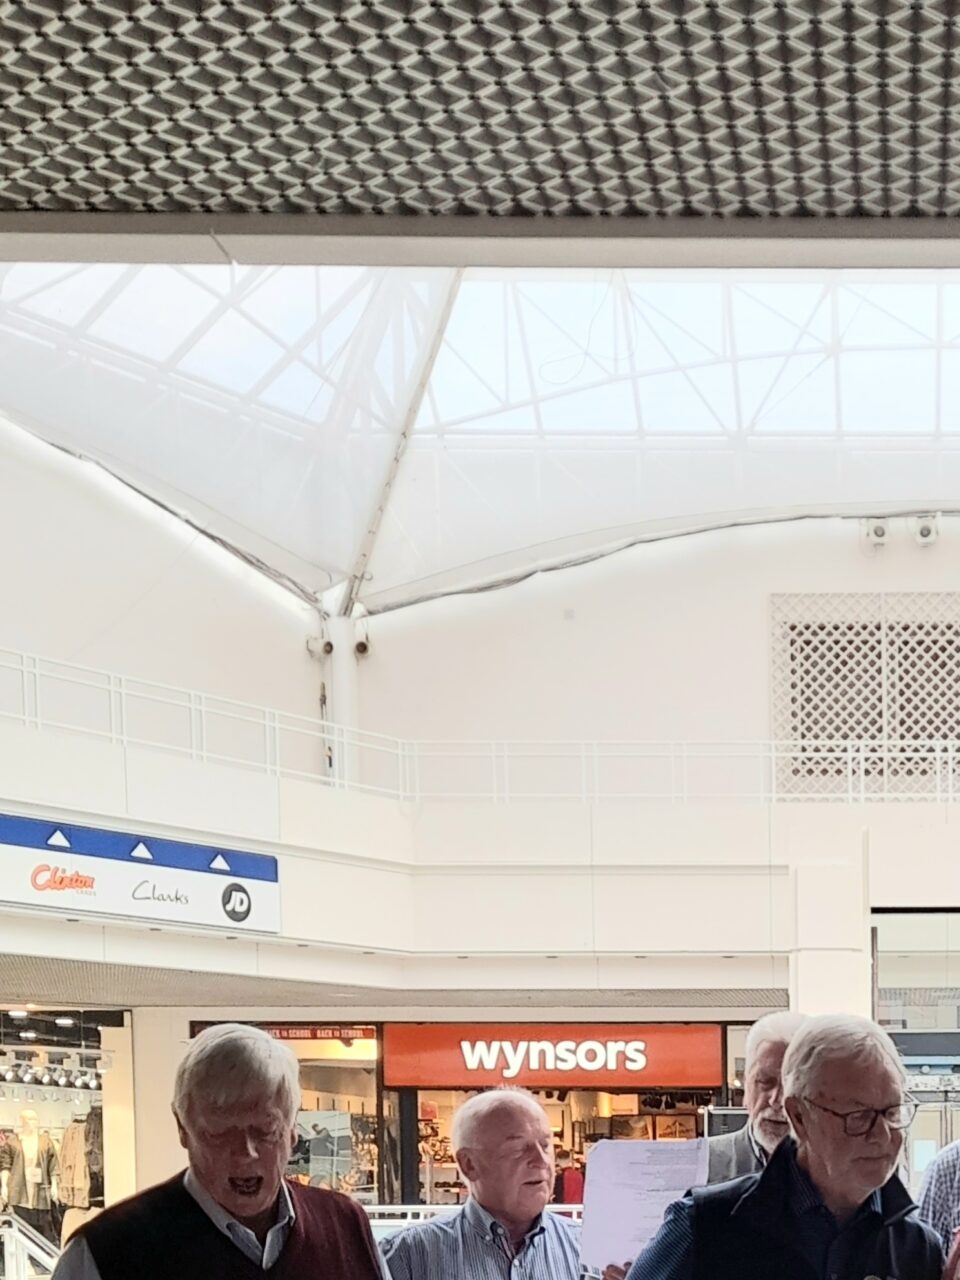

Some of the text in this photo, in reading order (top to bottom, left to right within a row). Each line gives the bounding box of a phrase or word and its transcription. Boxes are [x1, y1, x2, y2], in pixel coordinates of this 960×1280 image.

[31, 864, 95, 891] Clinton
[132, 880, 189, 905] Clarks
[225, 890, 249, 913] JD
[288, 1029, 312, 1038] SCHOOL
[316, 1029, 333, 1038] BACK
[341, 1029, 363, 1038] SCHOOL
[460, 1039, 648, 1078] wynsors
